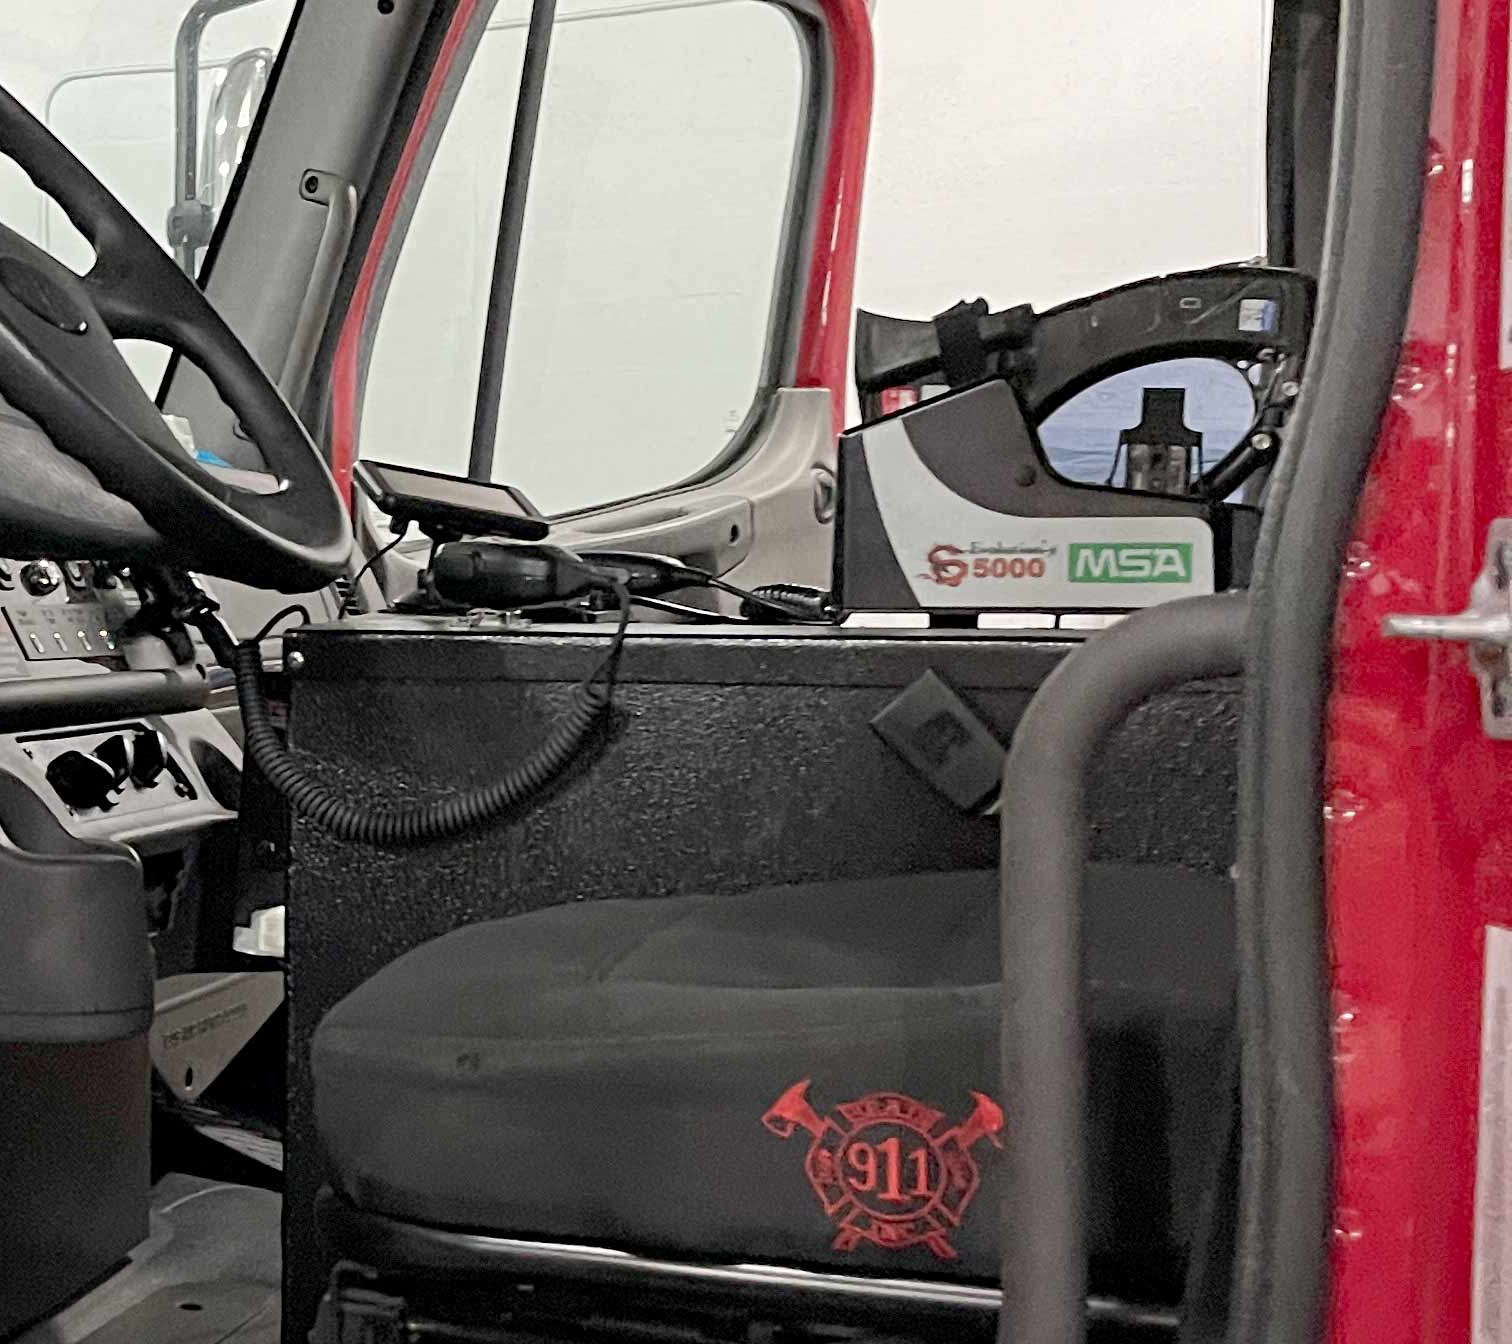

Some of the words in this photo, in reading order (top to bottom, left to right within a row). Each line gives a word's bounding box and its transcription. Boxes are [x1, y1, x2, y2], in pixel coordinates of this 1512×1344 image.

[972, 557, 1046, 578] 5000
[1075, 548, 1187, 578] MSA
[848, 1137, 933, 1200] 911
